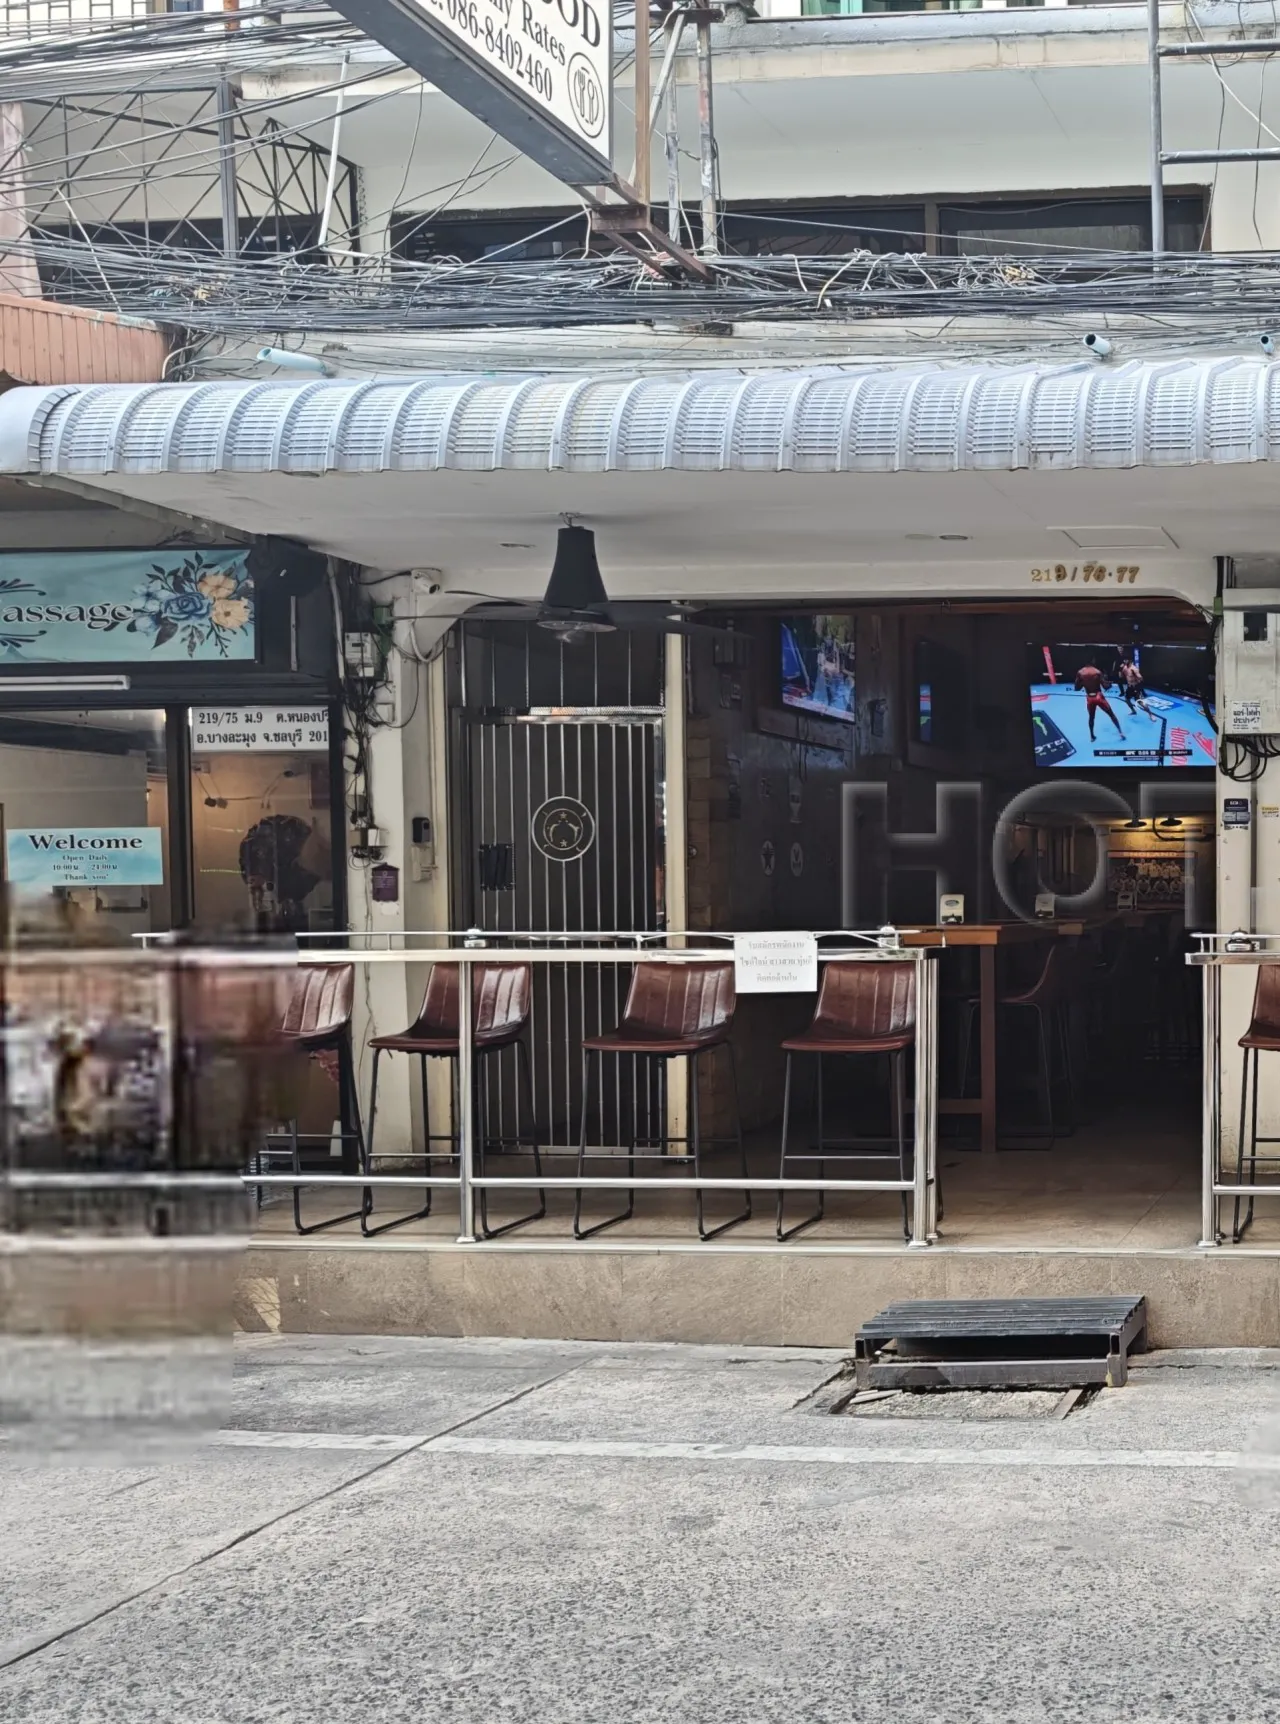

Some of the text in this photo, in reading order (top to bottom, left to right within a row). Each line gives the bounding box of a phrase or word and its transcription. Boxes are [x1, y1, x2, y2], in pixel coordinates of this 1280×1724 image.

[521, 0, 566, 67] Rates
[198, 711, 239, 727] 219/75
[244, 711, 263, 724] ม.9
[28, 834, 144, 850] Welcome
